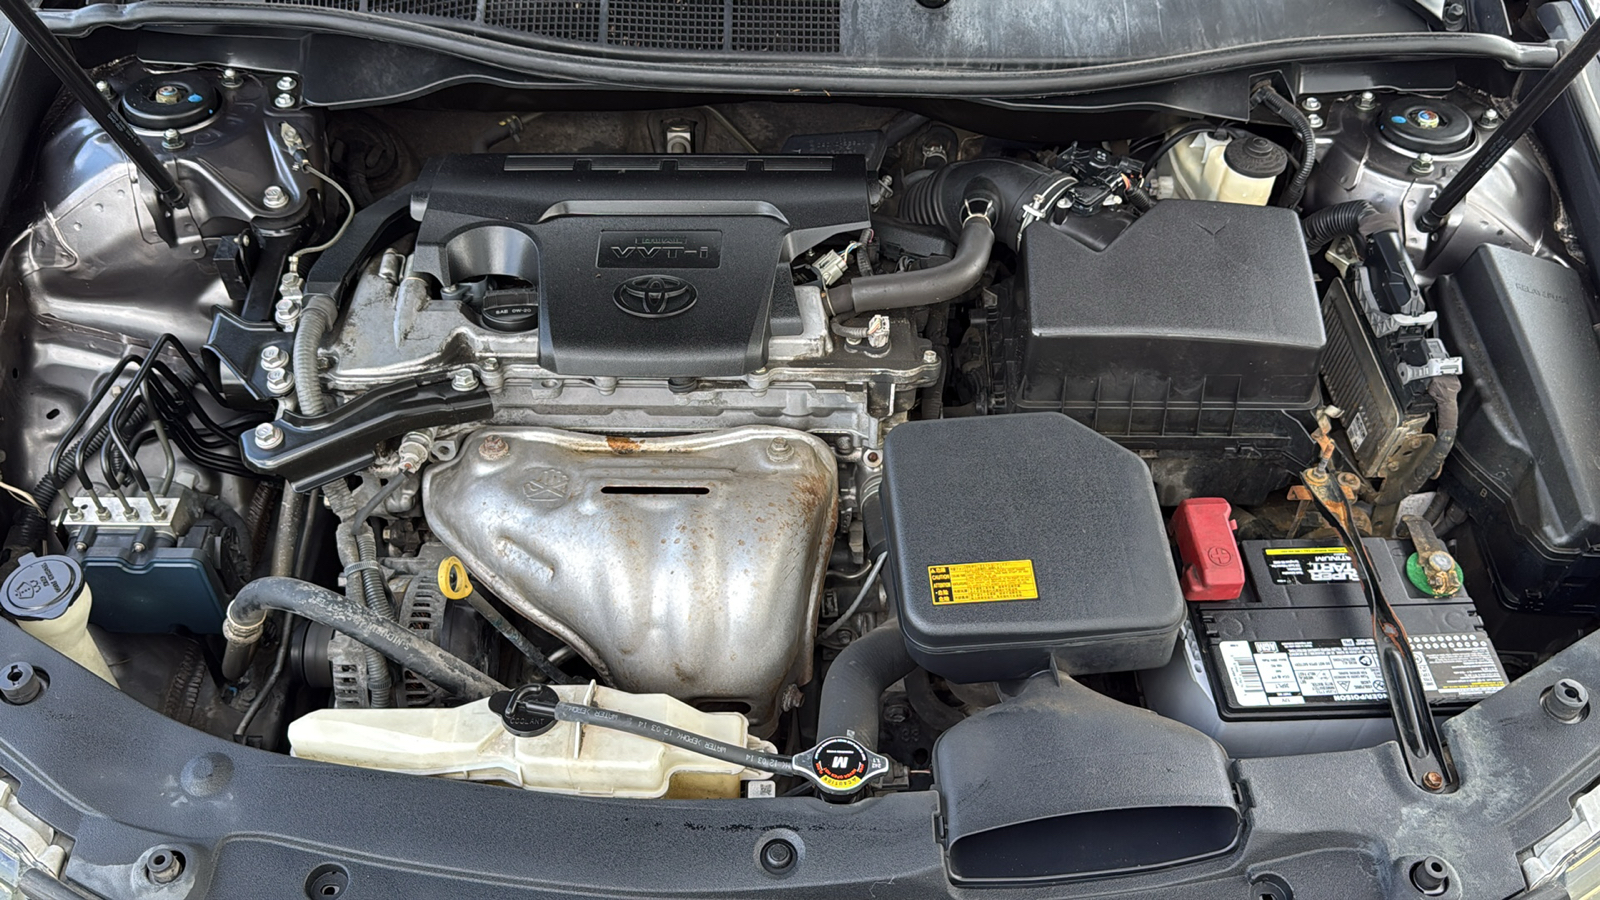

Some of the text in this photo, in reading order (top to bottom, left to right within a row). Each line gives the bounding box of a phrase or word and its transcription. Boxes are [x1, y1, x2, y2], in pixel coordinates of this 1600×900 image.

[610, 246, 709, 259] VVT-i
[510, 717, 545, 725] COOLANT
[637, 720, 648, 729] 14
[651, 724, 661, 733] 03
[663, 728, 673, 736] 12
[704, 741, 727, 754] WATER
[745, 753, 755, 763] 14
[831, 756, 849, 769] M
[824, 777, 852, 786] CAUTION
